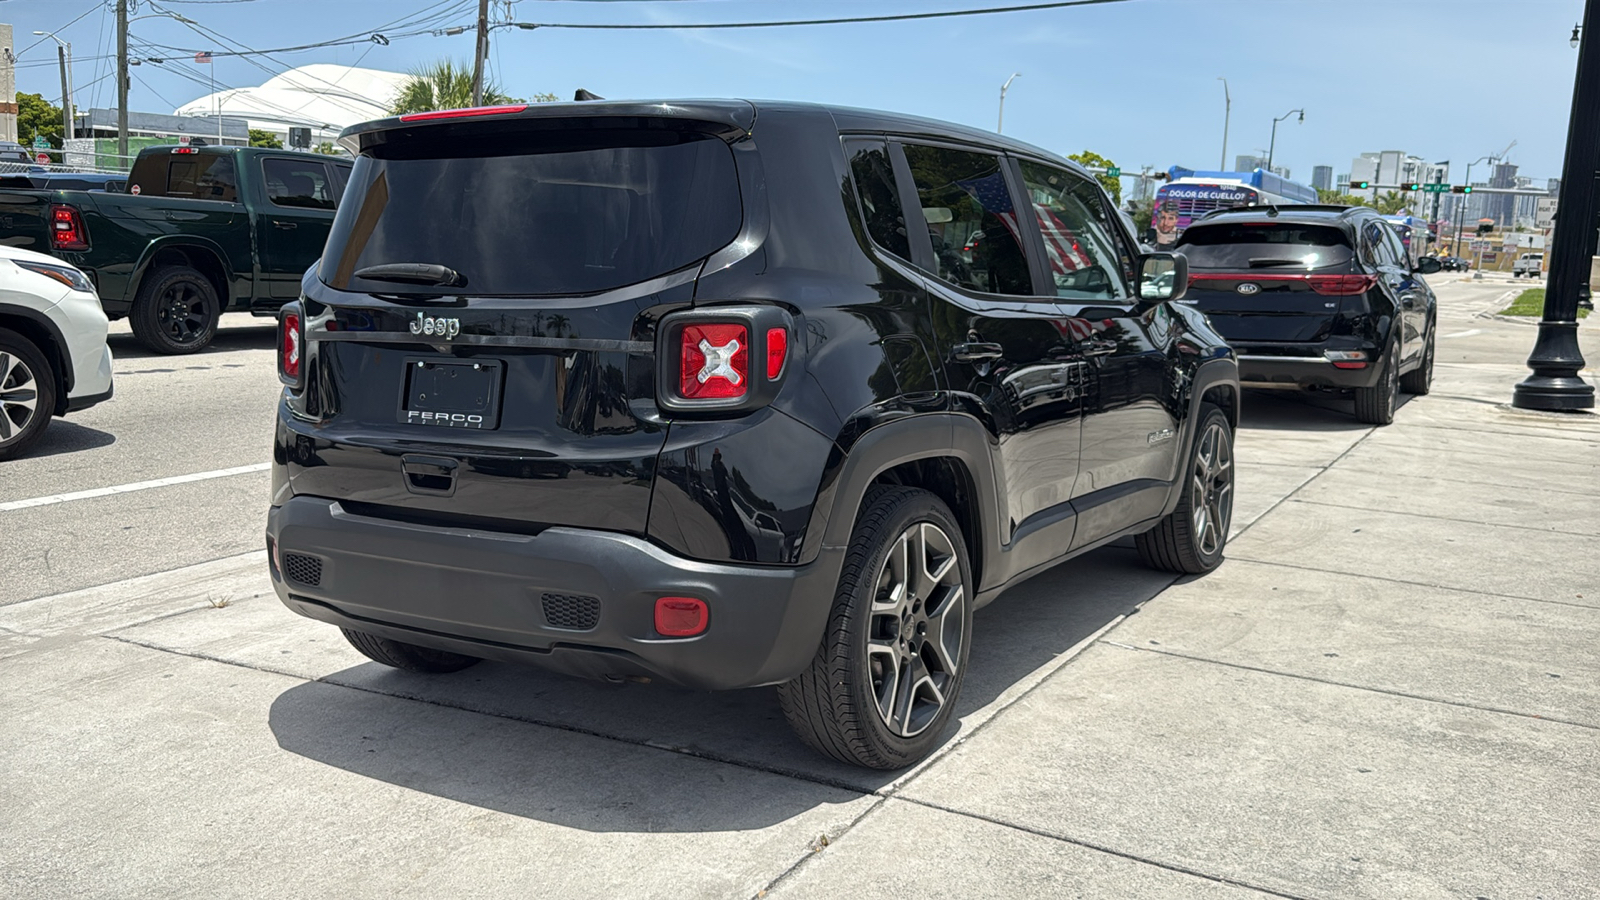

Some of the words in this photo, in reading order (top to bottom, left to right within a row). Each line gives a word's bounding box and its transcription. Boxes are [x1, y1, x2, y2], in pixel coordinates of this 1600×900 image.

[1198, 191, 1207, 199] DE
[1209, 191, 1245, 201] CUELLO?
[409, 311, 460, 340] Jeep
[407, 410, 483, 423] FERCO
